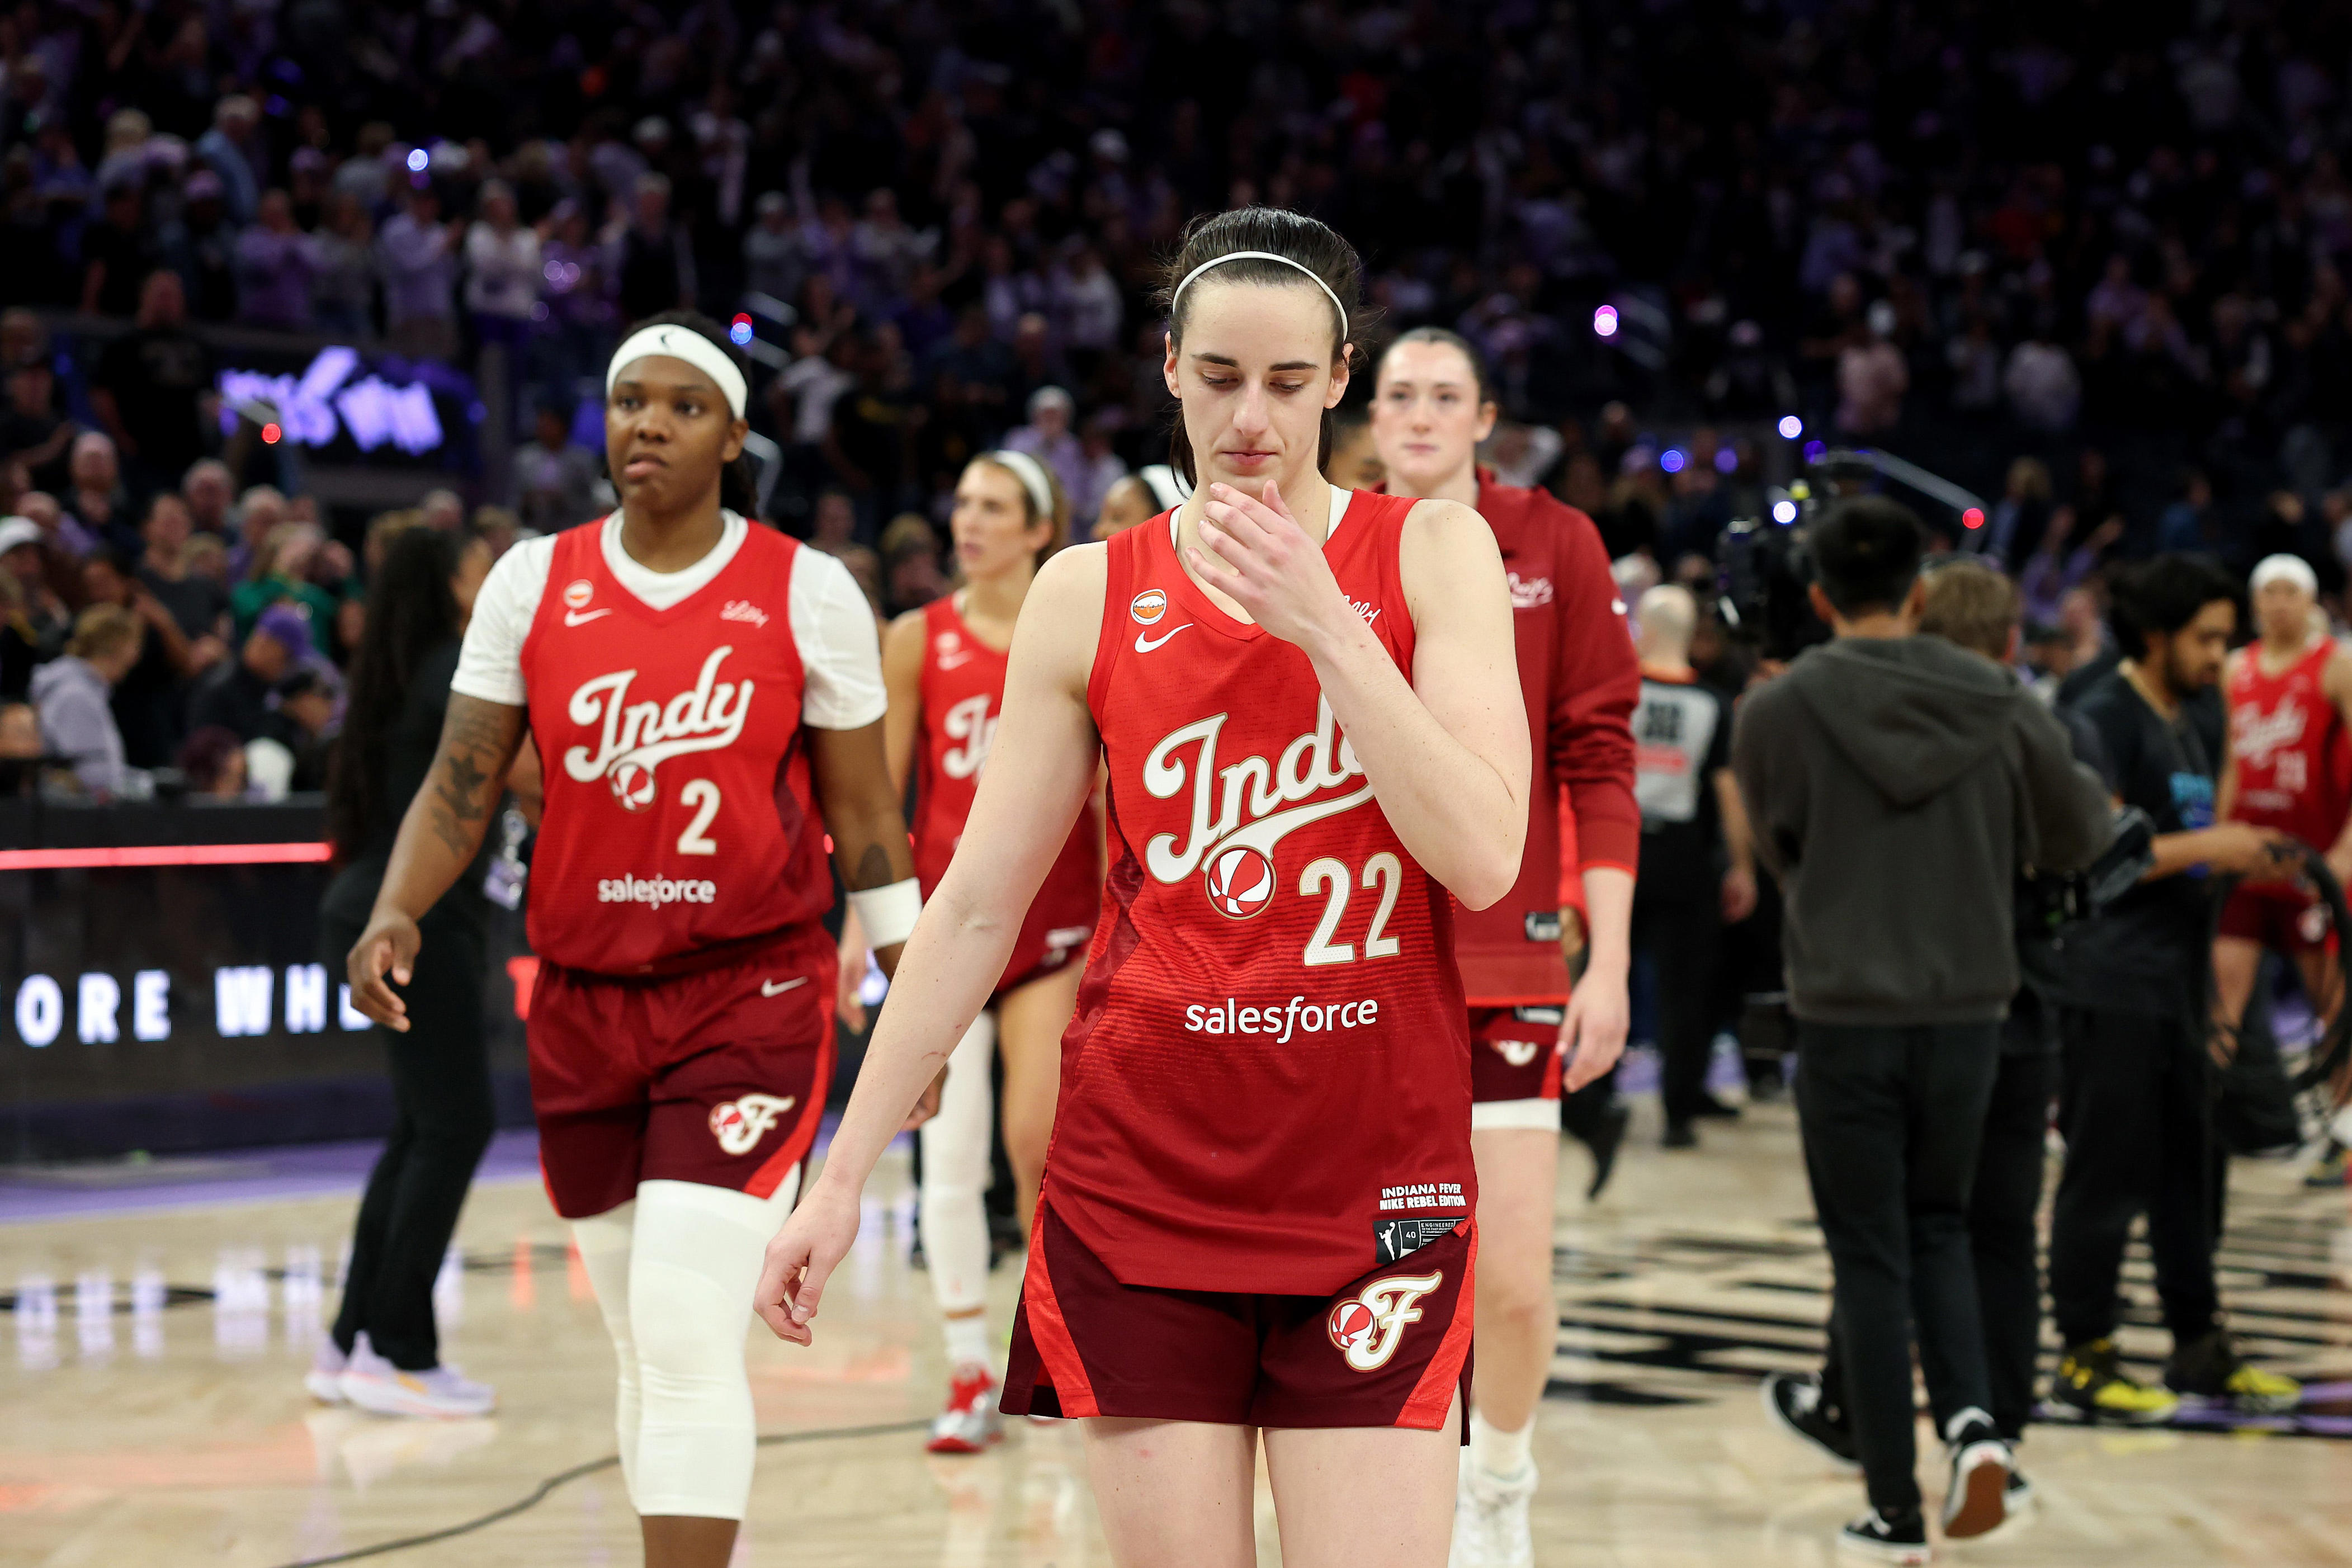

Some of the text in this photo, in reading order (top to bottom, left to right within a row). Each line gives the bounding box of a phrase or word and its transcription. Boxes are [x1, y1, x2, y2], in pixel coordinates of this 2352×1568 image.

[1344, 595, 1381, 626] lly
[564, 645, 754, 782] Indy
[677, 778, 721, 855] 2
[597, 872, 716, 910] salesforce
[1299, 851, 1402, 967] 22
[15, 969, 171, 1047] ORE
[1184, 995, 1378, 1044] salesforce
[1380, 1194, 1466, 1210] NIKE REBEL EDITION
[1382, 1183, 1461, 1198] INDIANA FEVER
